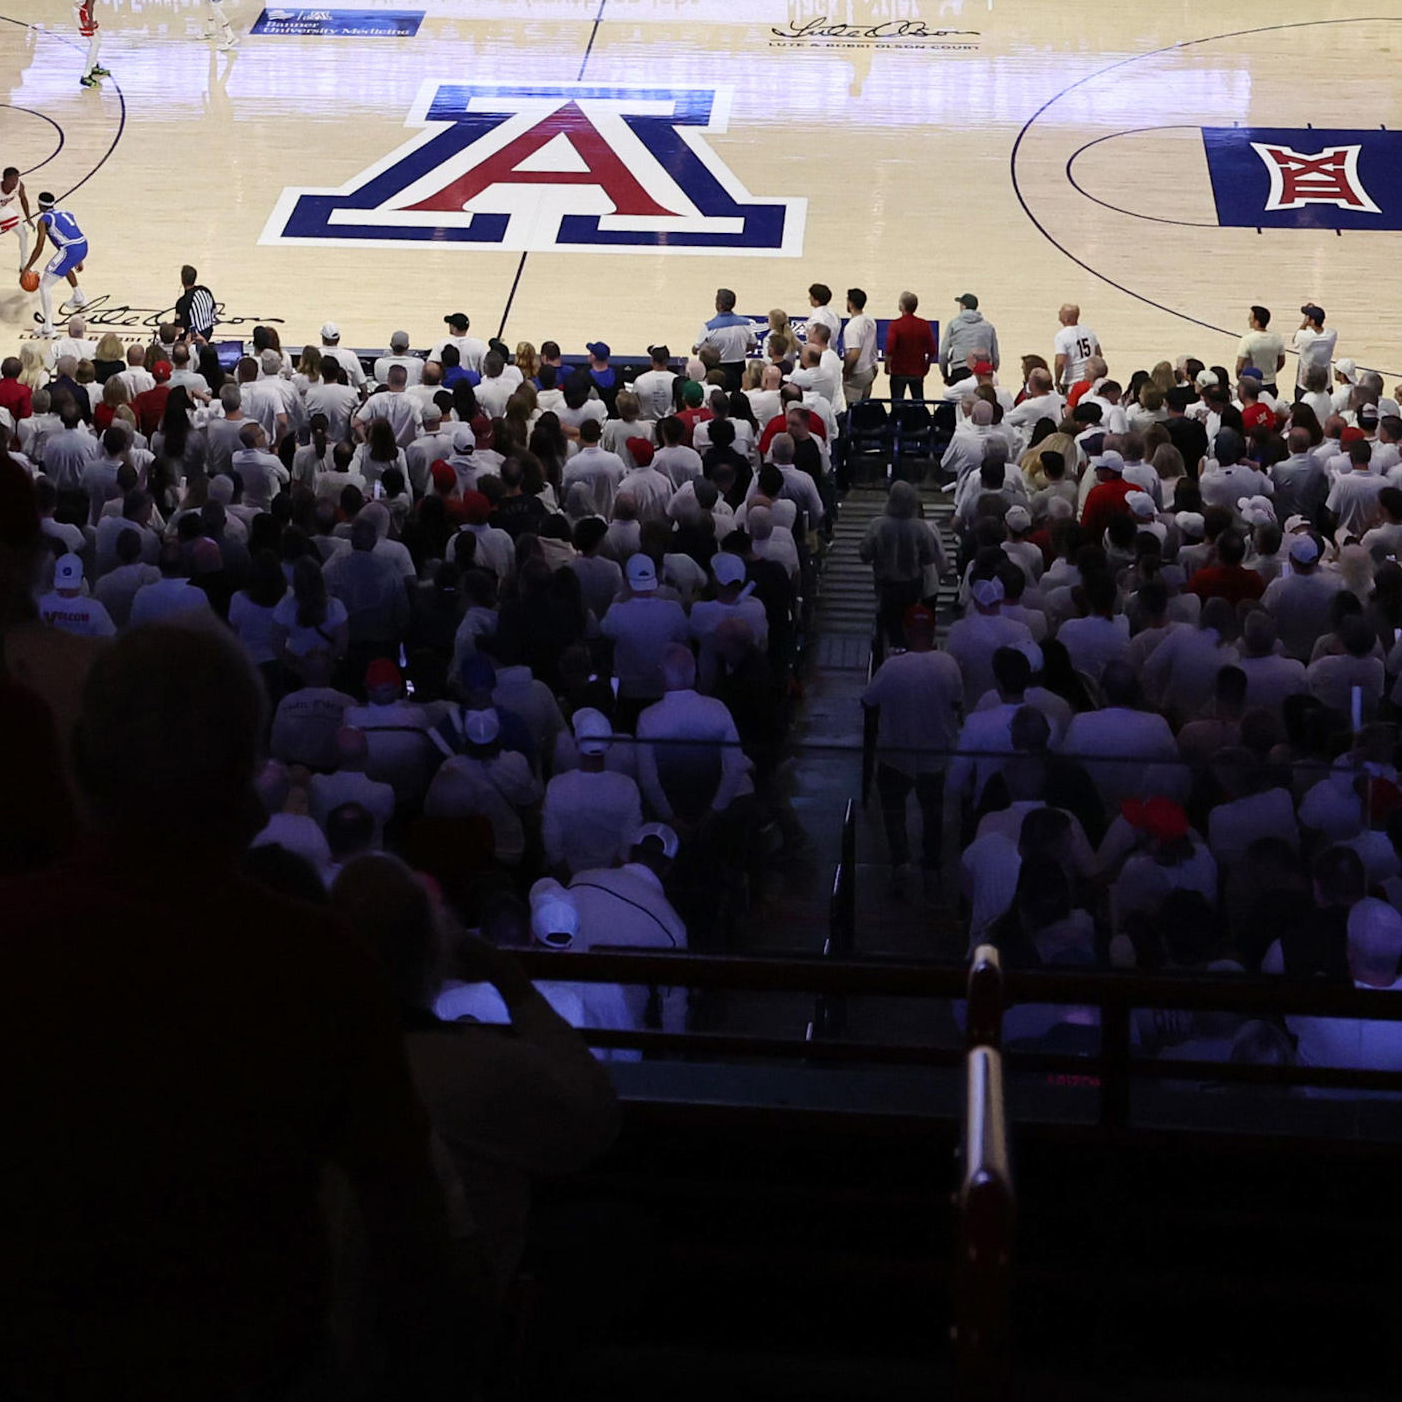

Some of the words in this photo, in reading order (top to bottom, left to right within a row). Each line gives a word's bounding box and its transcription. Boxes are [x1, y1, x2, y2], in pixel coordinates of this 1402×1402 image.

[263, 28, 338, 36] University
[266, 21, 319, 29] Banner
[257, 81, 808, 257] A
[1076, 337, 1091, 359] 15
